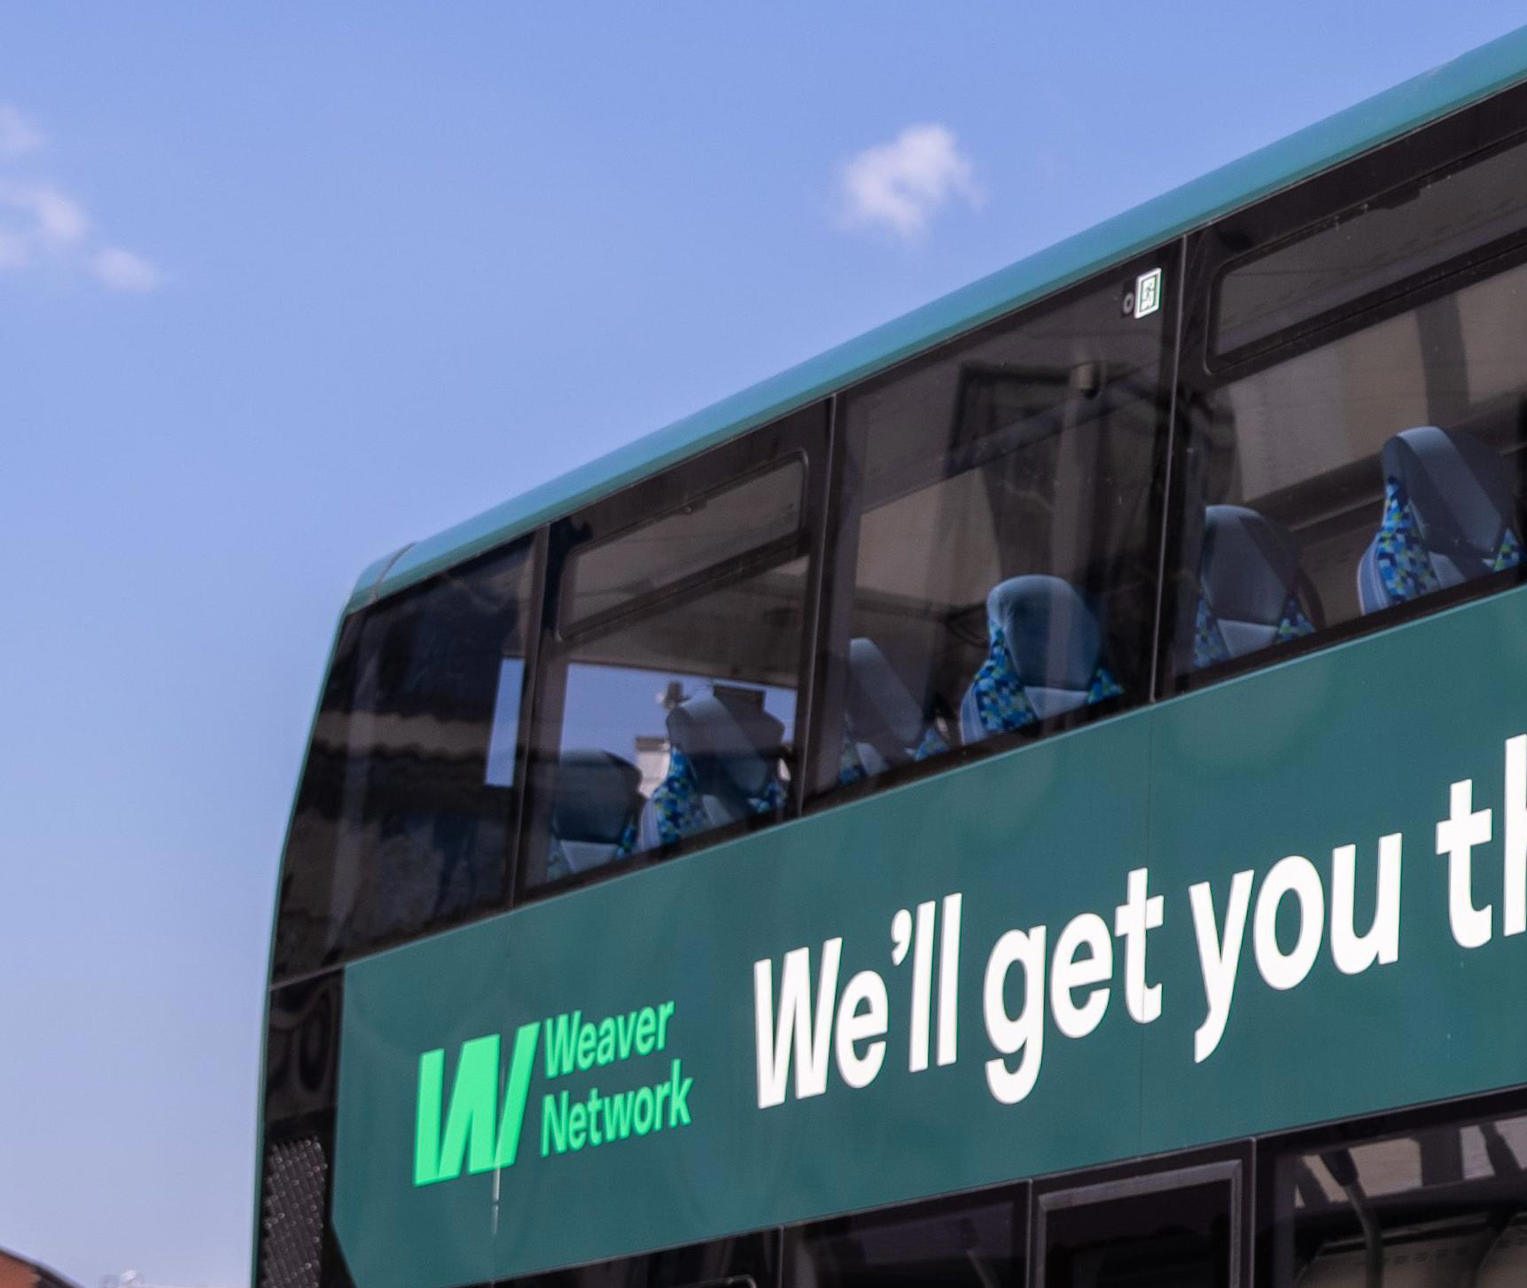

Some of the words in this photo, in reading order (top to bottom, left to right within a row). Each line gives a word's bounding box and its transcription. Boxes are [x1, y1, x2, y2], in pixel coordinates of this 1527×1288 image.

[755, 893, 962, 1109] We’ll
[984, 868, 1164, 1104] get
[1189, 833, 1402, 1064] you
[544, 1001, 675, 1079] Weaver
[540, 1059, 693, 1158] Network
